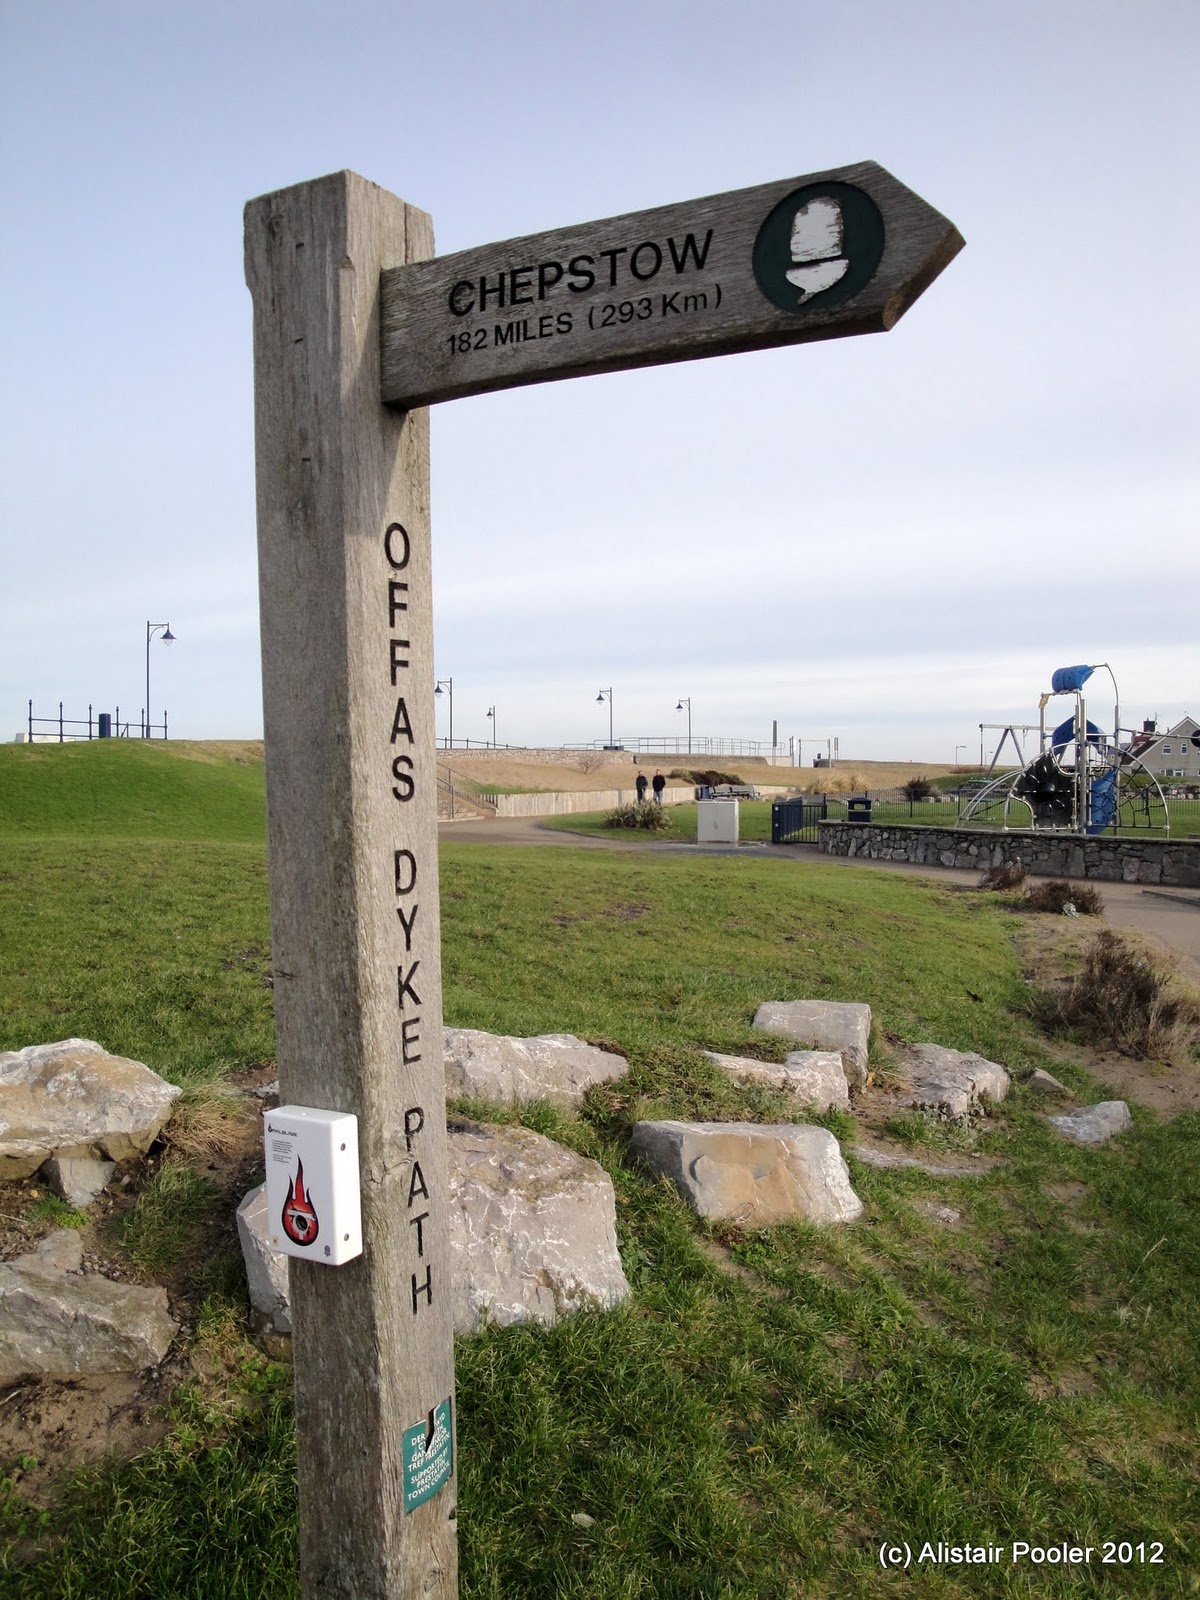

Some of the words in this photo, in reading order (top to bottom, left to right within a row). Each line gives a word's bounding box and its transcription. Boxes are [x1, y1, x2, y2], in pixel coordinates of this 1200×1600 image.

[447, 328, 487, 355] 182
[494, 312, 573, 346] MILES
[588, 297, 653, 331] (293
[449, 229, 714, 317] CHEPSTOW
[384, 522, 415, 802] OFFAS
[394, 849, 423, 1066] DYKE
[404, 1106, 432, 1315] PATH
[408, 1481, 430, 1501] TOWN
